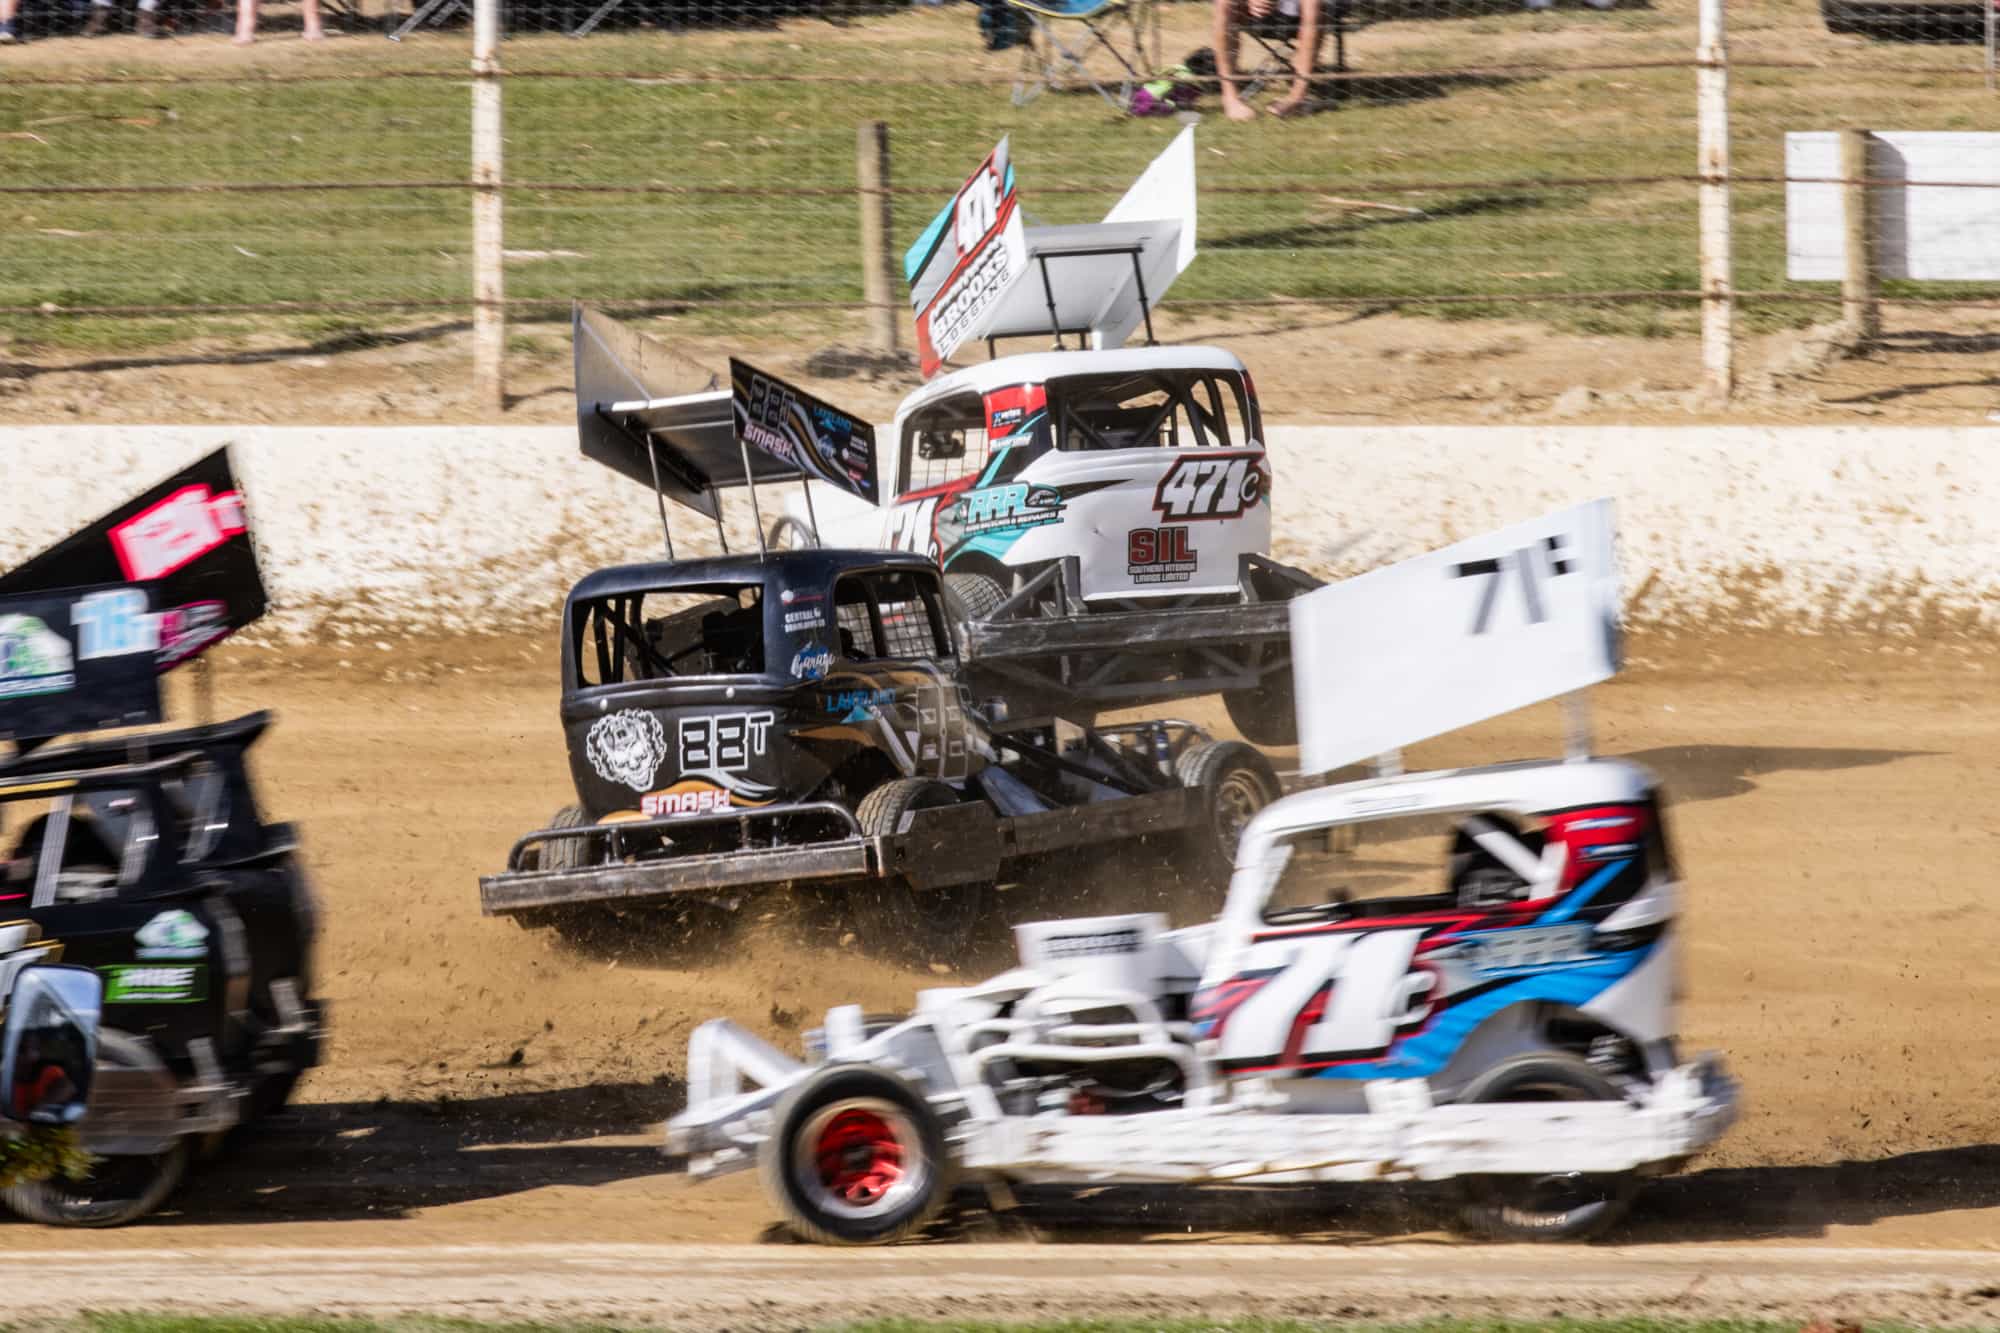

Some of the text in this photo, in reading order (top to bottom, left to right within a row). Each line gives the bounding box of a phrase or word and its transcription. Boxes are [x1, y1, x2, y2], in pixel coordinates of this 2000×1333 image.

[743, 422, 796, 459] SMASH
[1129, 526, 1197, 564] SIL
[641, 789, 733, 816] SMASH
